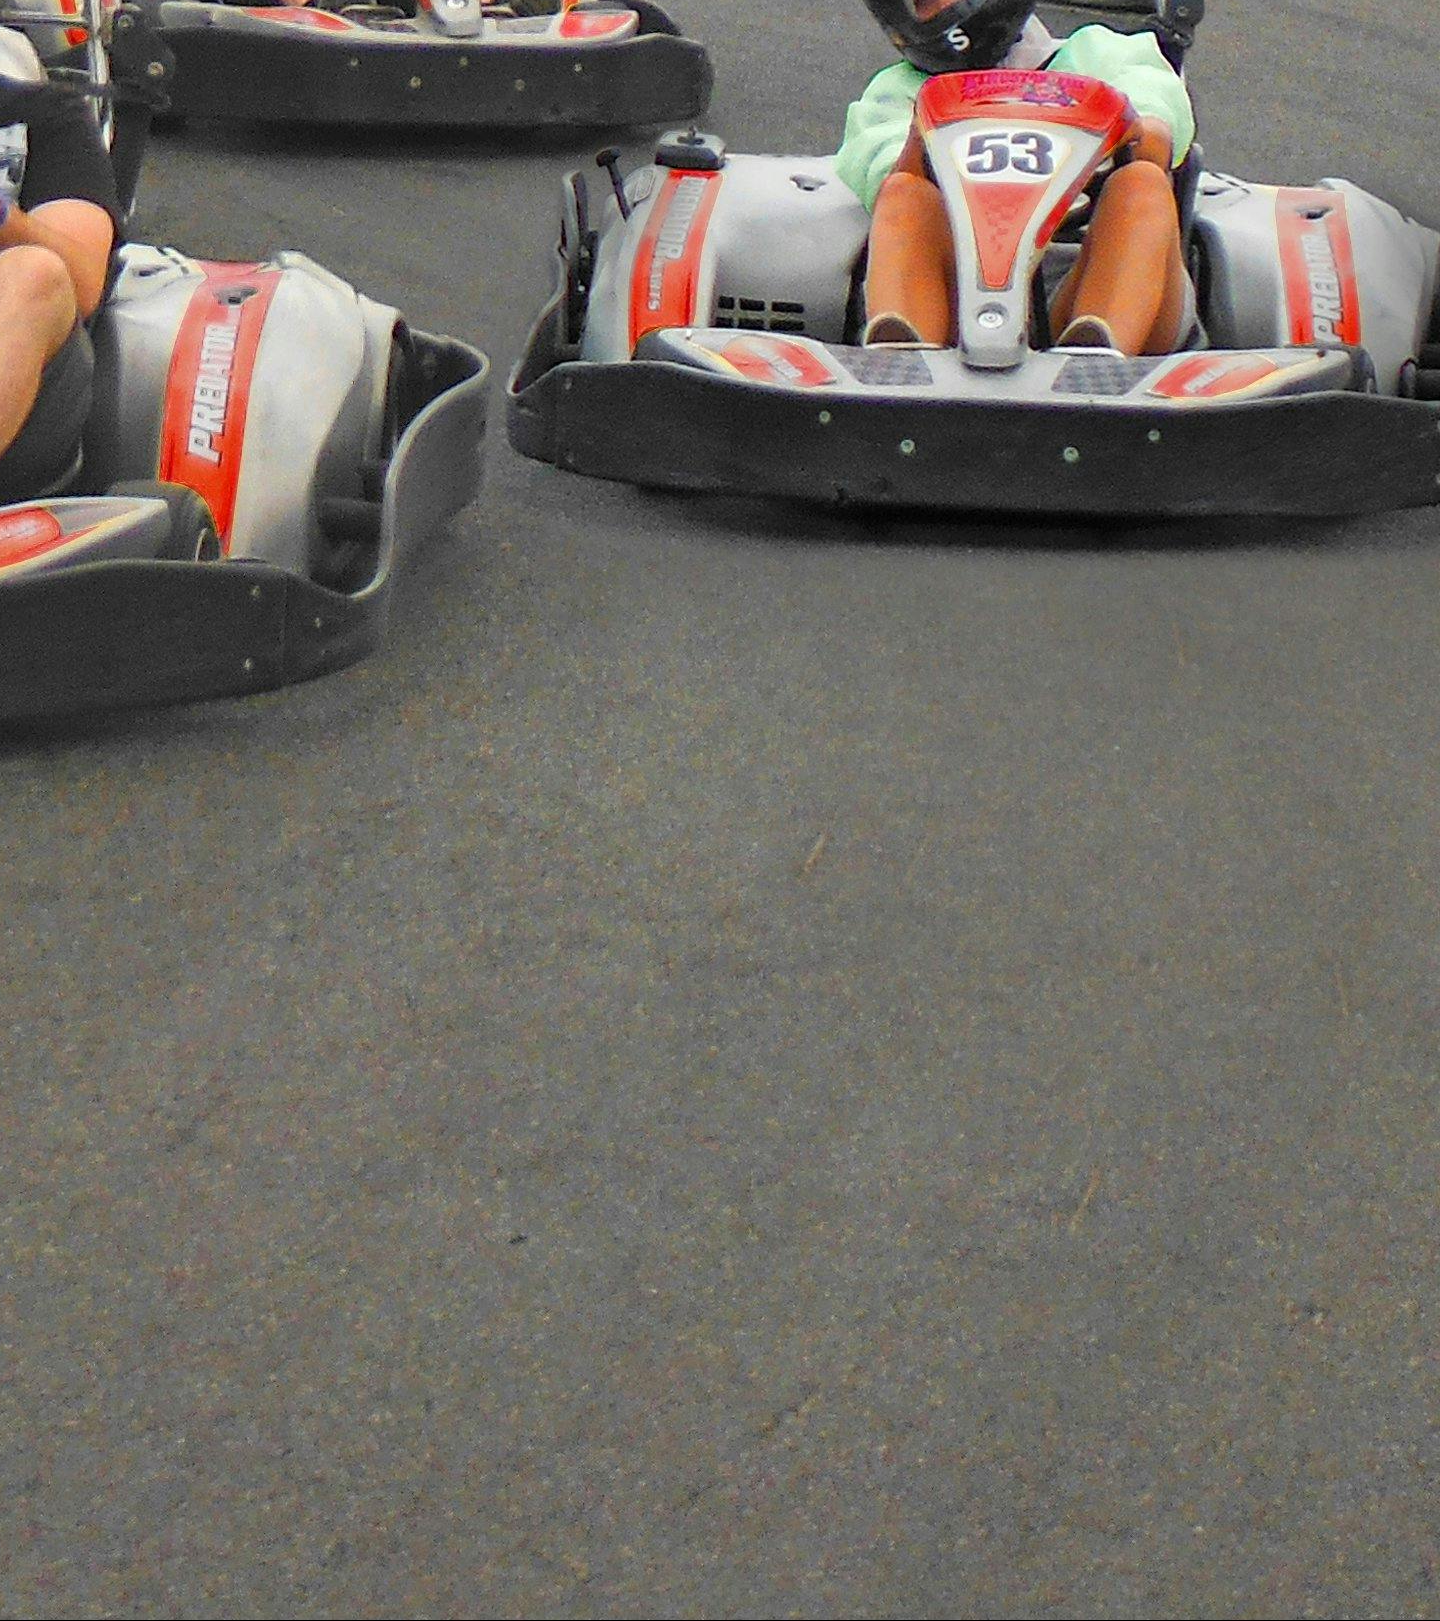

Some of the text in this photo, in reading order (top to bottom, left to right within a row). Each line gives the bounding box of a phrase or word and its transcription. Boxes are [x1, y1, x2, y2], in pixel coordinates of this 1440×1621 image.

[947, 27, 971, 52] S
[966, 131, 1054, 175] 53
[654, 176, 709, 260] PREDATOR
[1301, 233, 1344, 343] PREDATOR
[187, 324, 238, 465] PREDATOR
